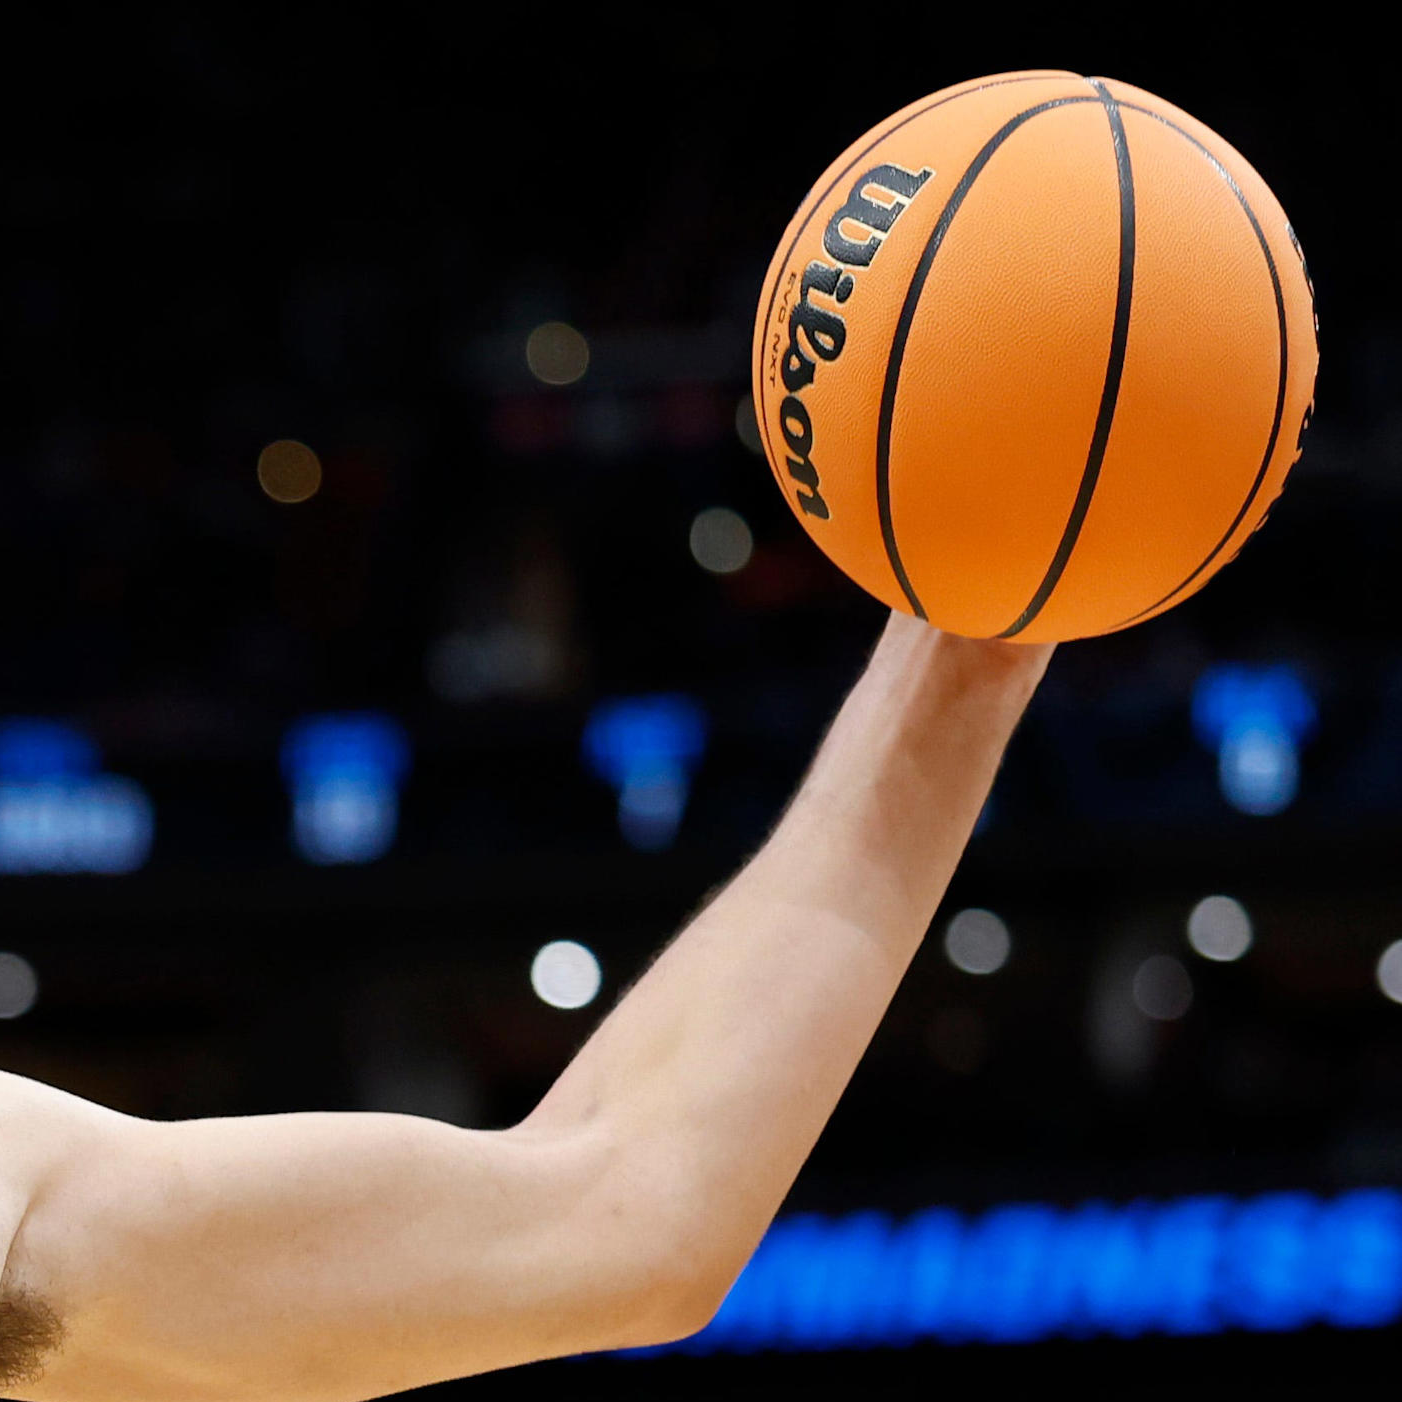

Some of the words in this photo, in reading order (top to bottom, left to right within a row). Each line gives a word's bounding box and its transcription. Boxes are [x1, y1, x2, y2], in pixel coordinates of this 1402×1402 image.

[778, 271, 797, 324] EVO
[769, 332, 781, 388] NXT
[779, 162, 936, 521] Wilson
